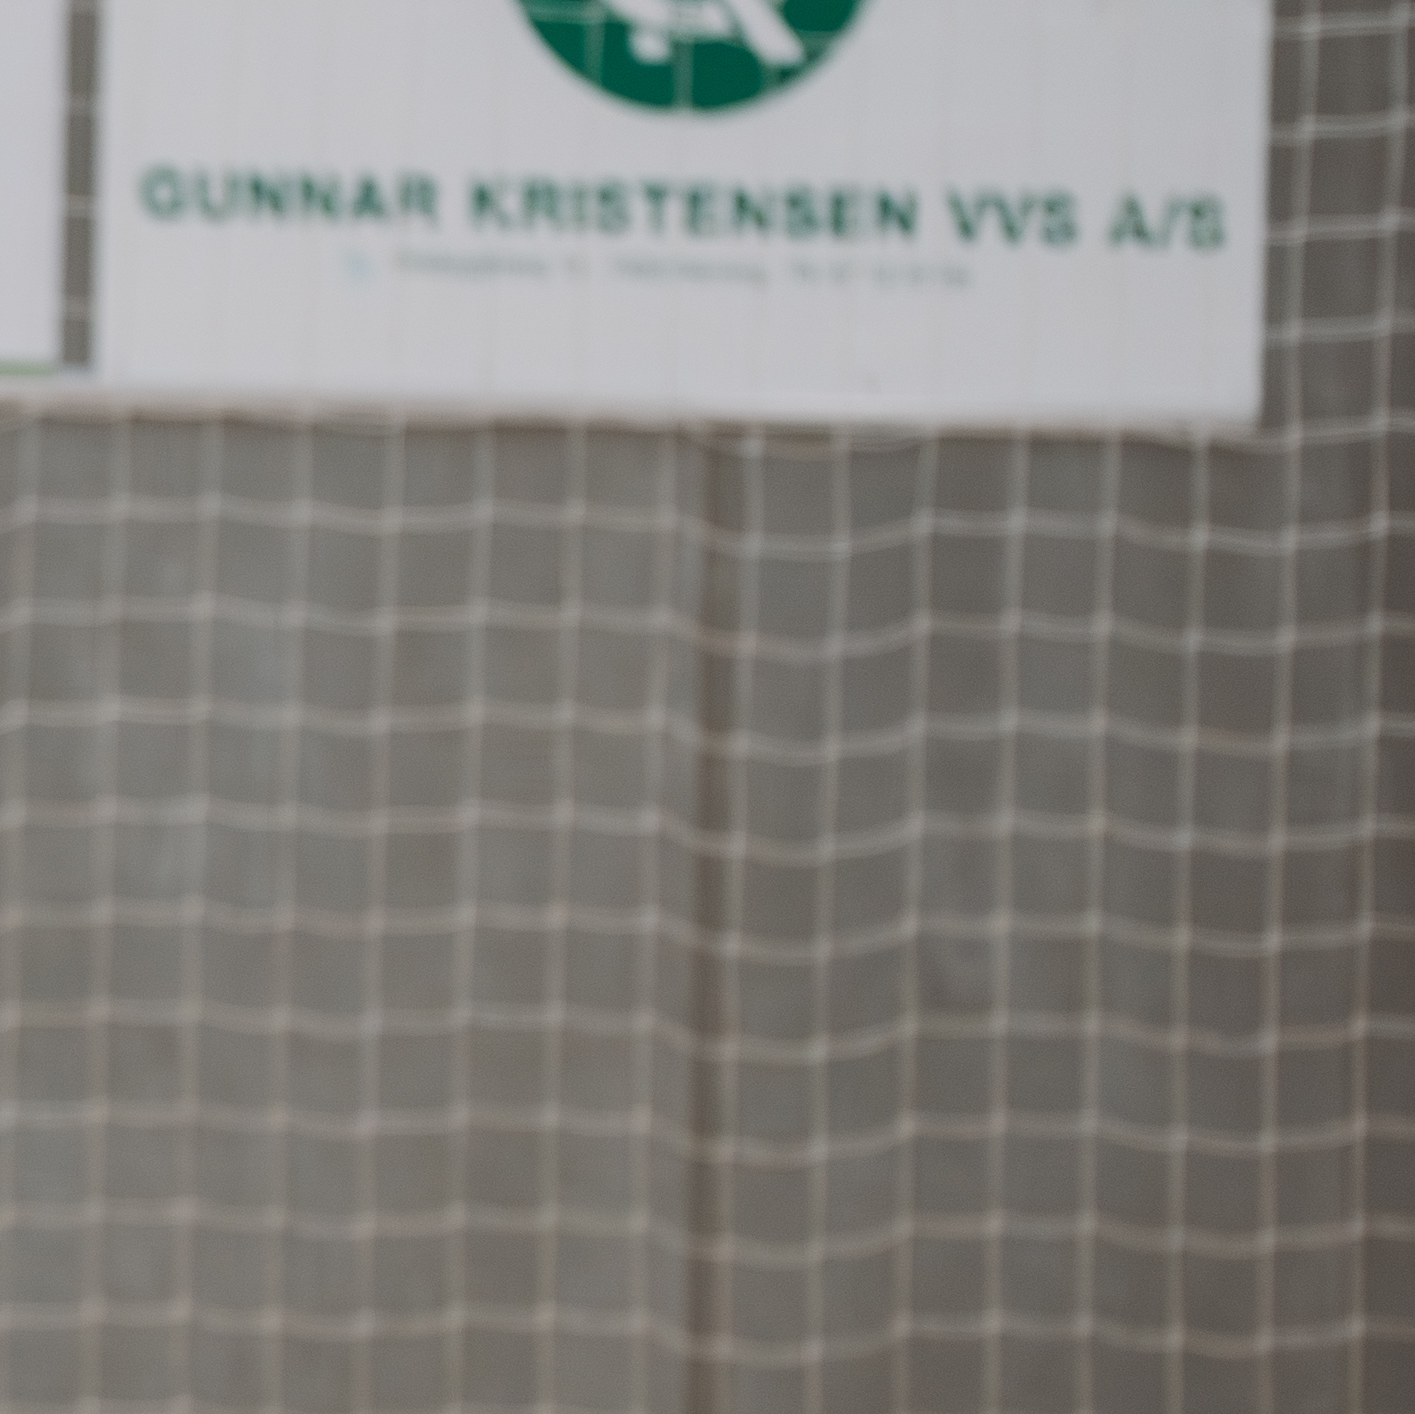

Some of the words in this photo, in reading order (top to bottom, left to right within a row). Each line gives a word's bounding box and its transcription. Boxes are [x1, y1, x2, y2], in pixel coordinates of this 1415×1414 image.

[139, 165, 439, 230] GUNNAR
[469, 175, 917, 242] KRISTENSEN
[947, 186, 1079, 250] VVS
[1108, 191, 1226, 252] A/S
